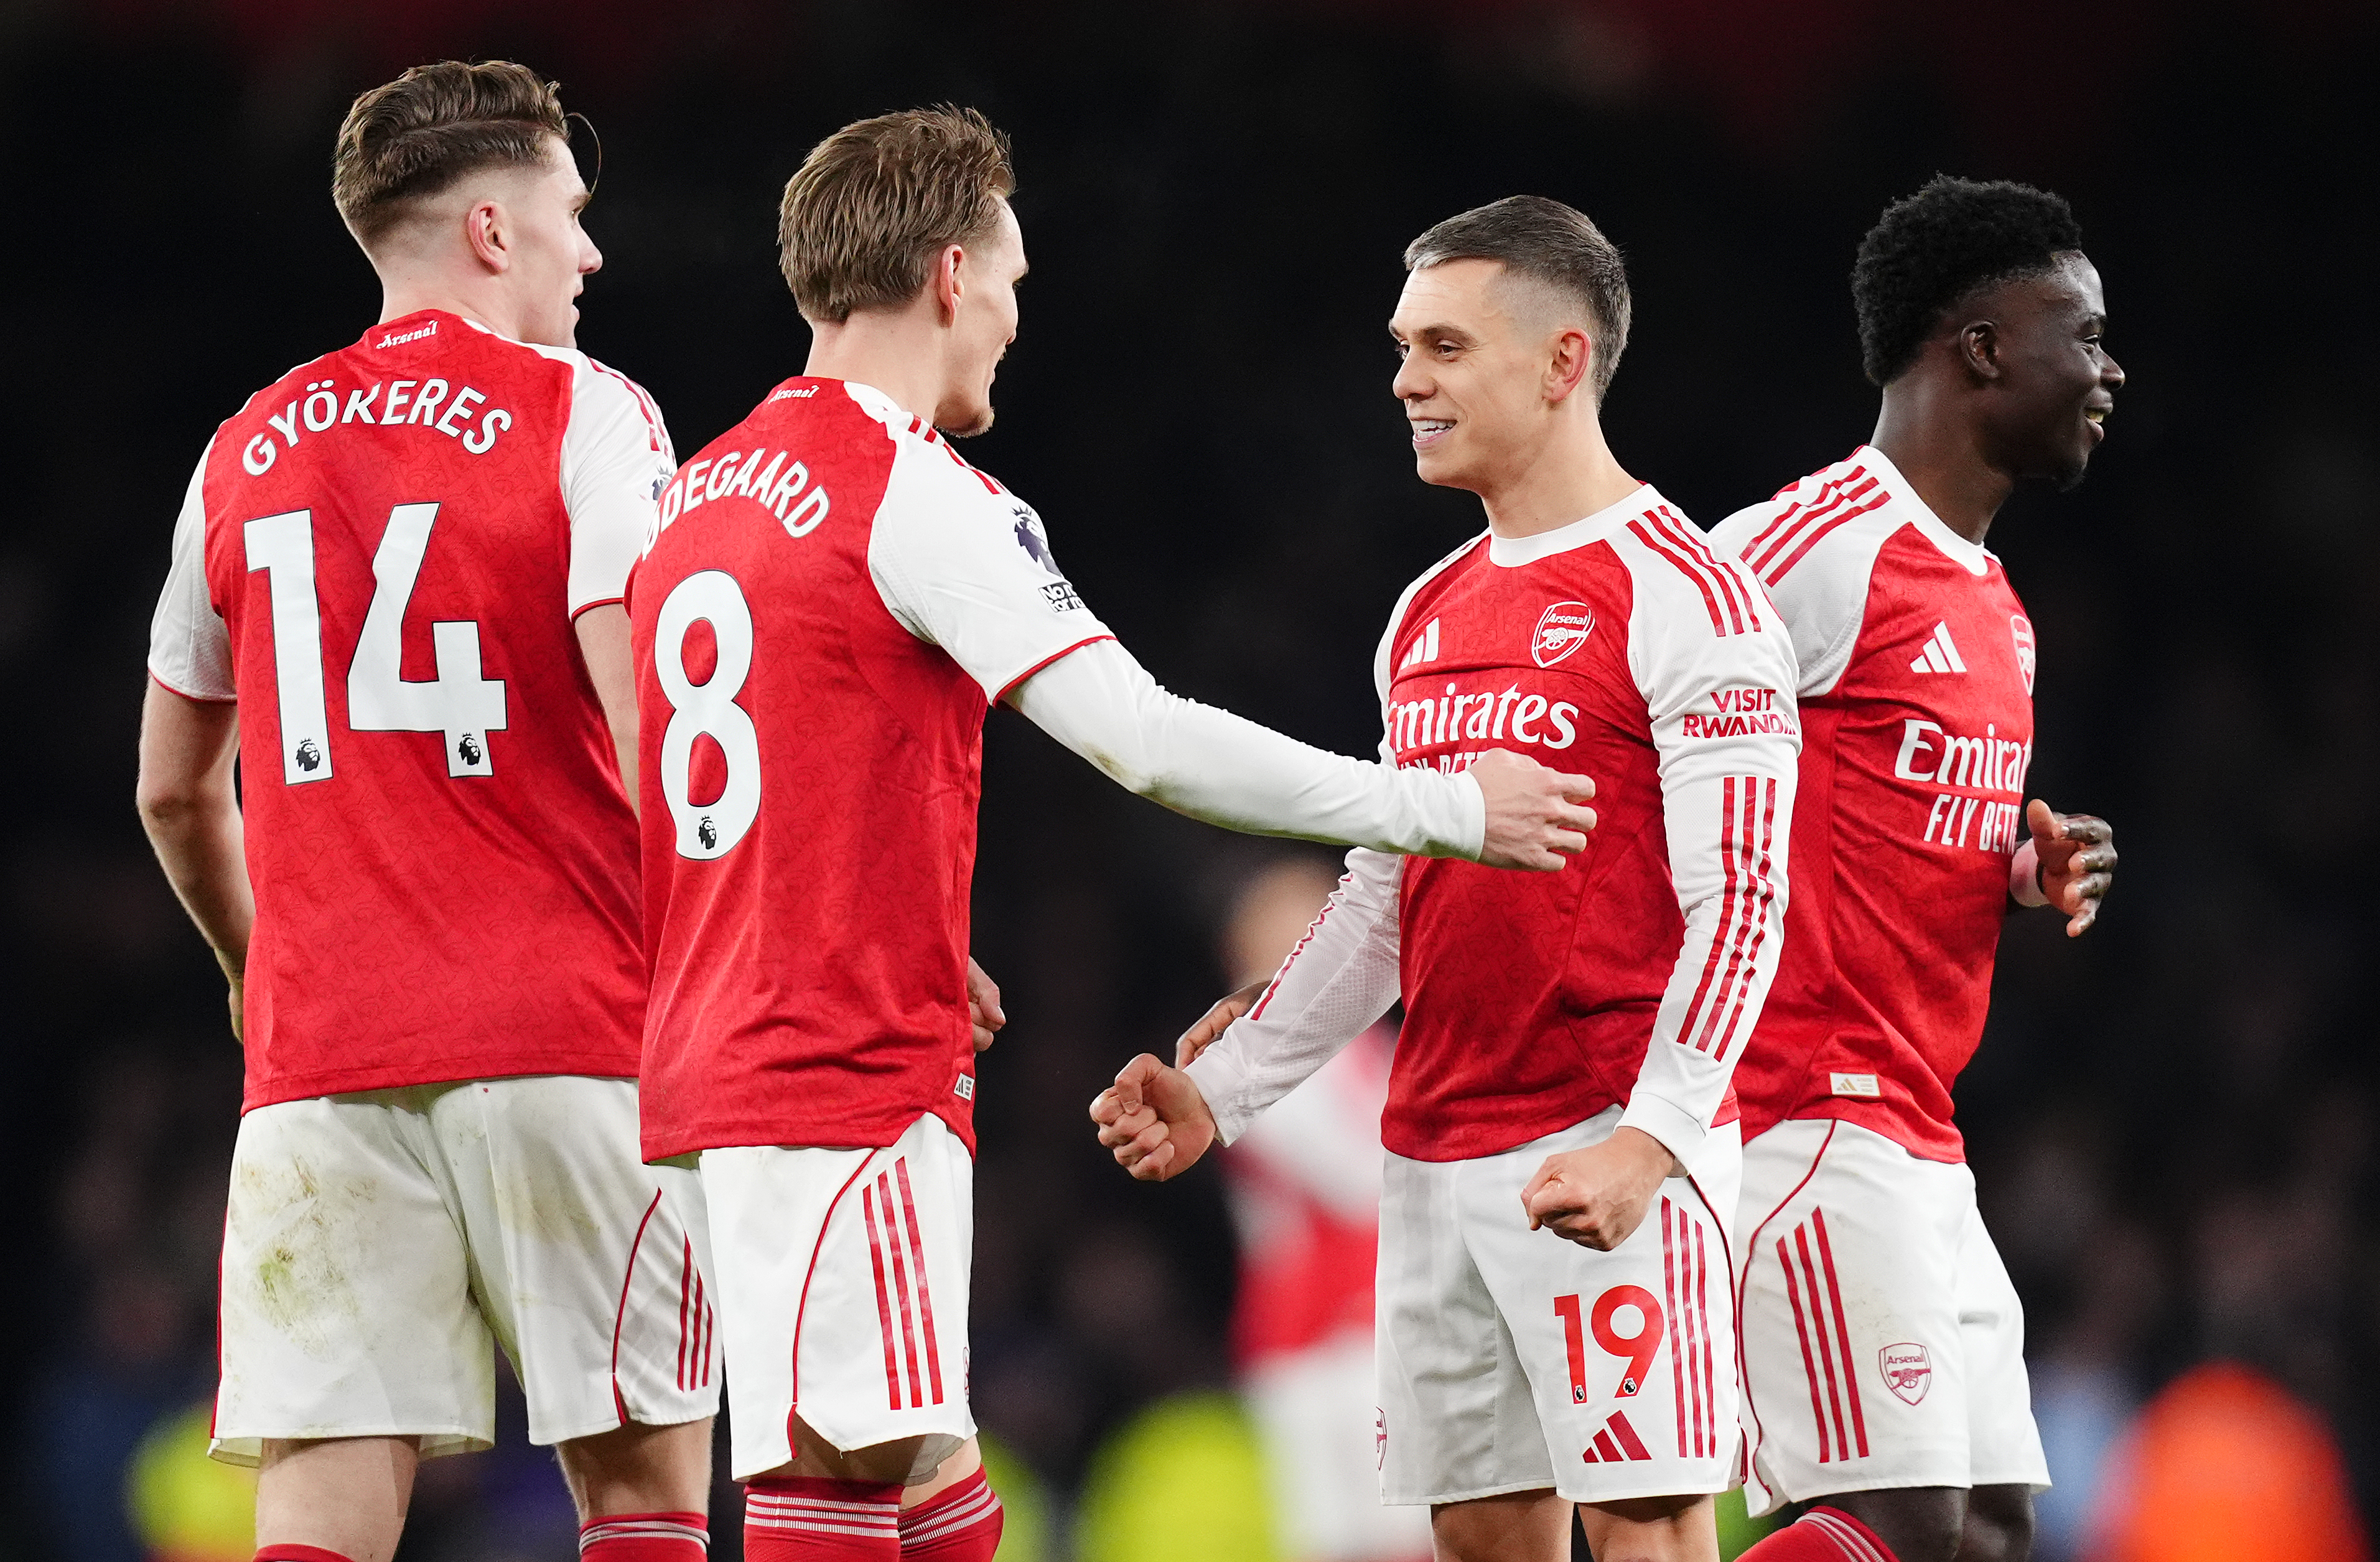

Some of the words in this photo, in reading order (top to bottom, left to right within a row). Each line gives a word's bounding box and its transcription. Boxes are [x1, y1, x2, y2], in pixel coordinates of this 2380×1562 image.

[376, 320, 439, 349] Arsenal
[242, 378, 512, 476] GYÖKERES
[243, 502, 508, 785] 14
[1545, 613, 1589, 625] Arsenal
[655, 569, 762, 861] 8
[1389, 682, 1580, 750] mirates
[1710, 688, 1776, 713] VISIT
[1894, 718, 2032, 793] Emirat
[1923, 793, 1980, 848] FLY
[1553, 1284, 1664, 1405] 19
[1887, 1353, 1925, 1365] Arsenal
